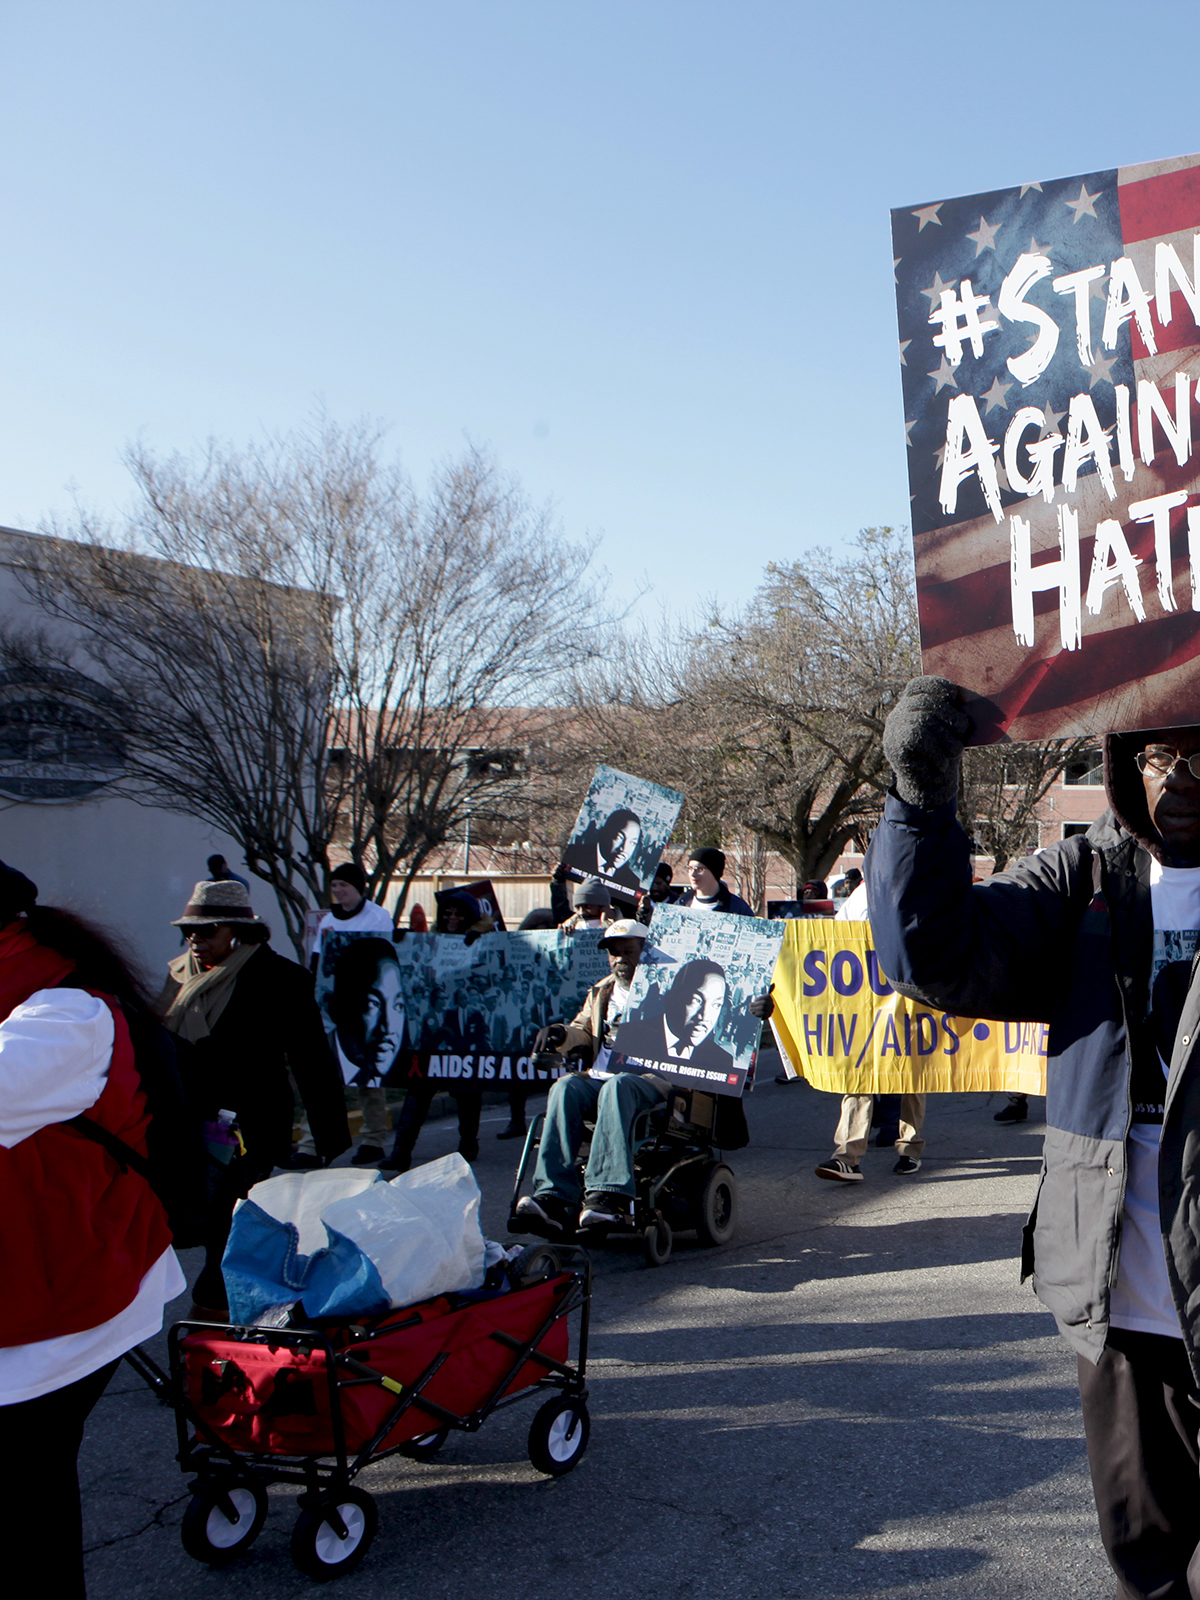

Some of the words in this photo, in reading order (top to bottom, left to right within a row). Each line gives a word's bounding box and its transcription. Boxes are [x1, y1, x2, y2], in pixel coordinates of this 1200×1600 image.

[803, 1008, 961, 1069] HIV/AIDS
[427, 1055, 474, 1078] AIDS
[477, 1056, 496, 1079] IS
[499, 1056, 512, 1080] A
[625, 1056, 644, 1067] AIDS
[644, 1060, 653, 1069] IS
[652, 1061, 659, 1070] A
[659, 1062, 678, 1073] CIVIL
[678, 1064, 707, 1079] RIGHTS
[706, 1070, 728, 1083] ISSUE
